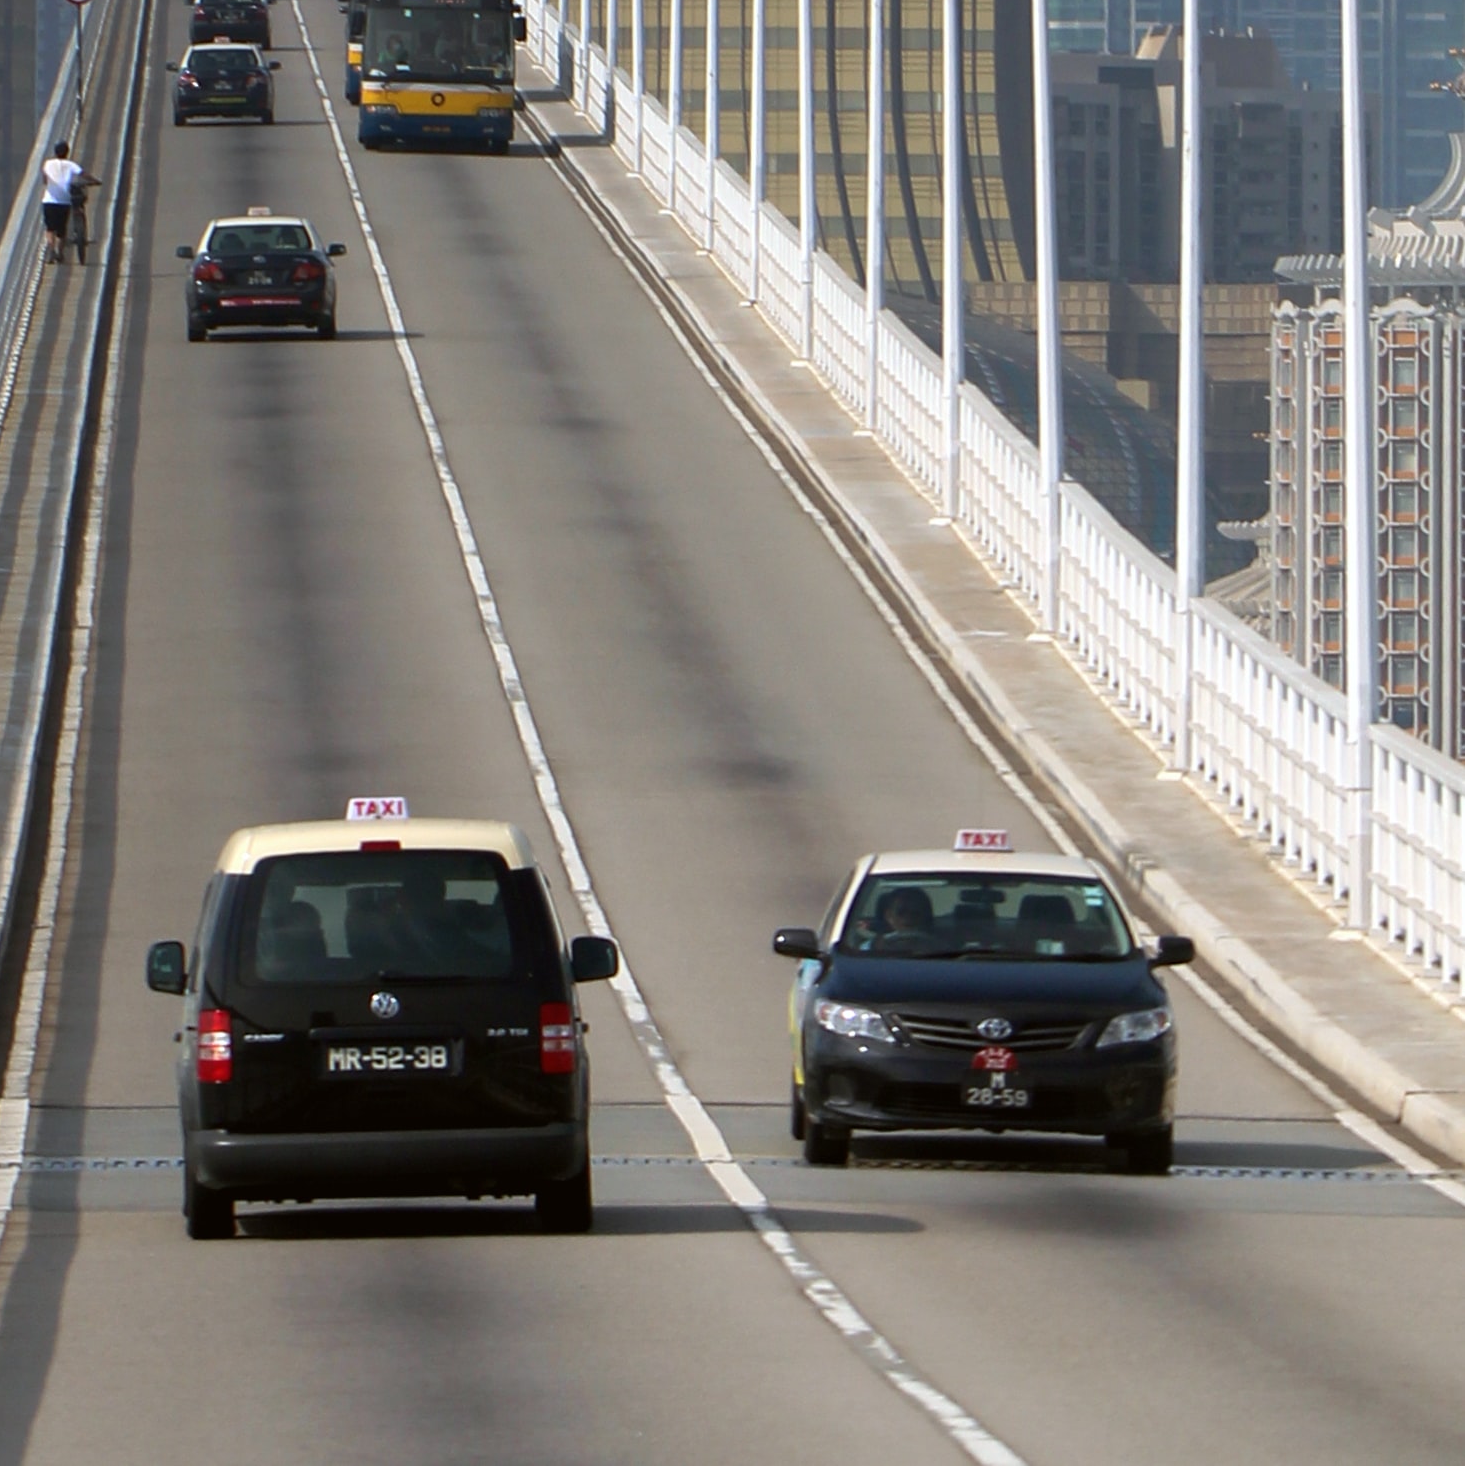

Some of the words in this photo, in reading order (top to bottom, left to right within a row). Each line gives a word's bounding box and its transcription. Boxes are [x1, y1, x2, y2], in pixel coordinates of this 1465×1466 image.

[353, 800, 403, 816] TAXI
[961, 832, 1008, 846] TAXI
[328, 1046, 448, 1072] MR-52-38
[990, 1071, 1007, 1089] M
[966, 1087, 1029, 1107] 28-59
